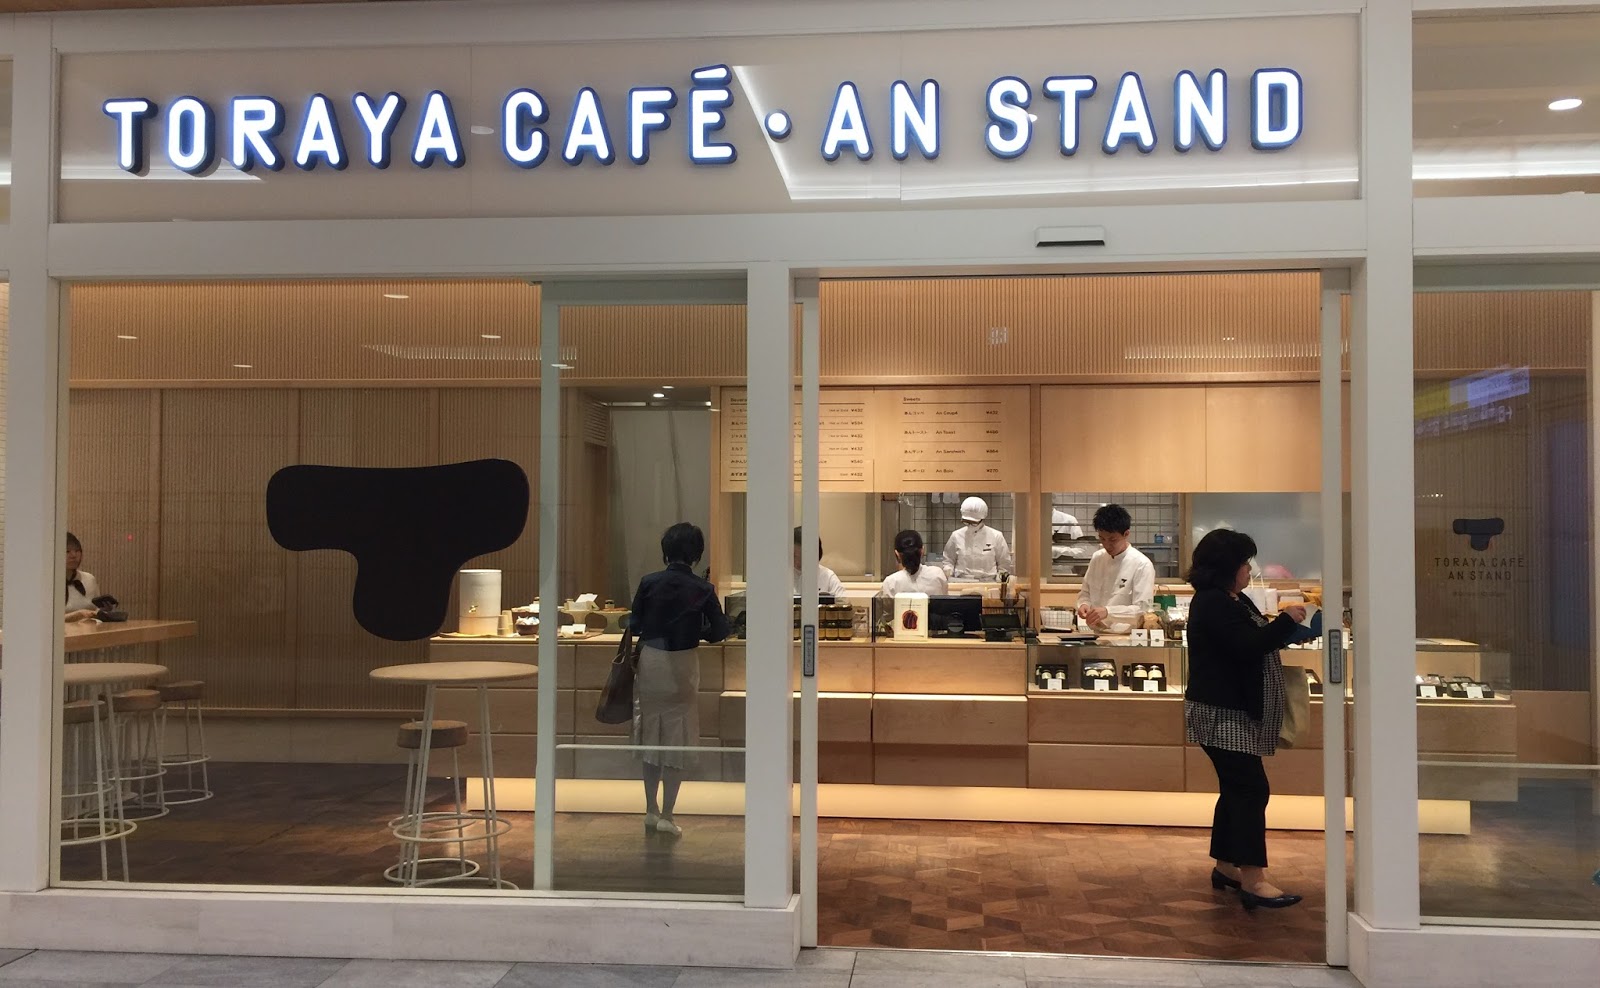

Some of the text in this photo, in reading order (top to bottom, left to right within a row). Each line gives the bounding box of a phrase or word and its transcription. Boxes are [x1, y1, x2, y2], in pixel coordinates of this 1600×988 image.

[102, 64, 1303, 175] TORAYA CAFÉ AN STAND
[1434, 558, 1486, 568] TORAYA
[1448, 571, 1512, 580] AN STAND
